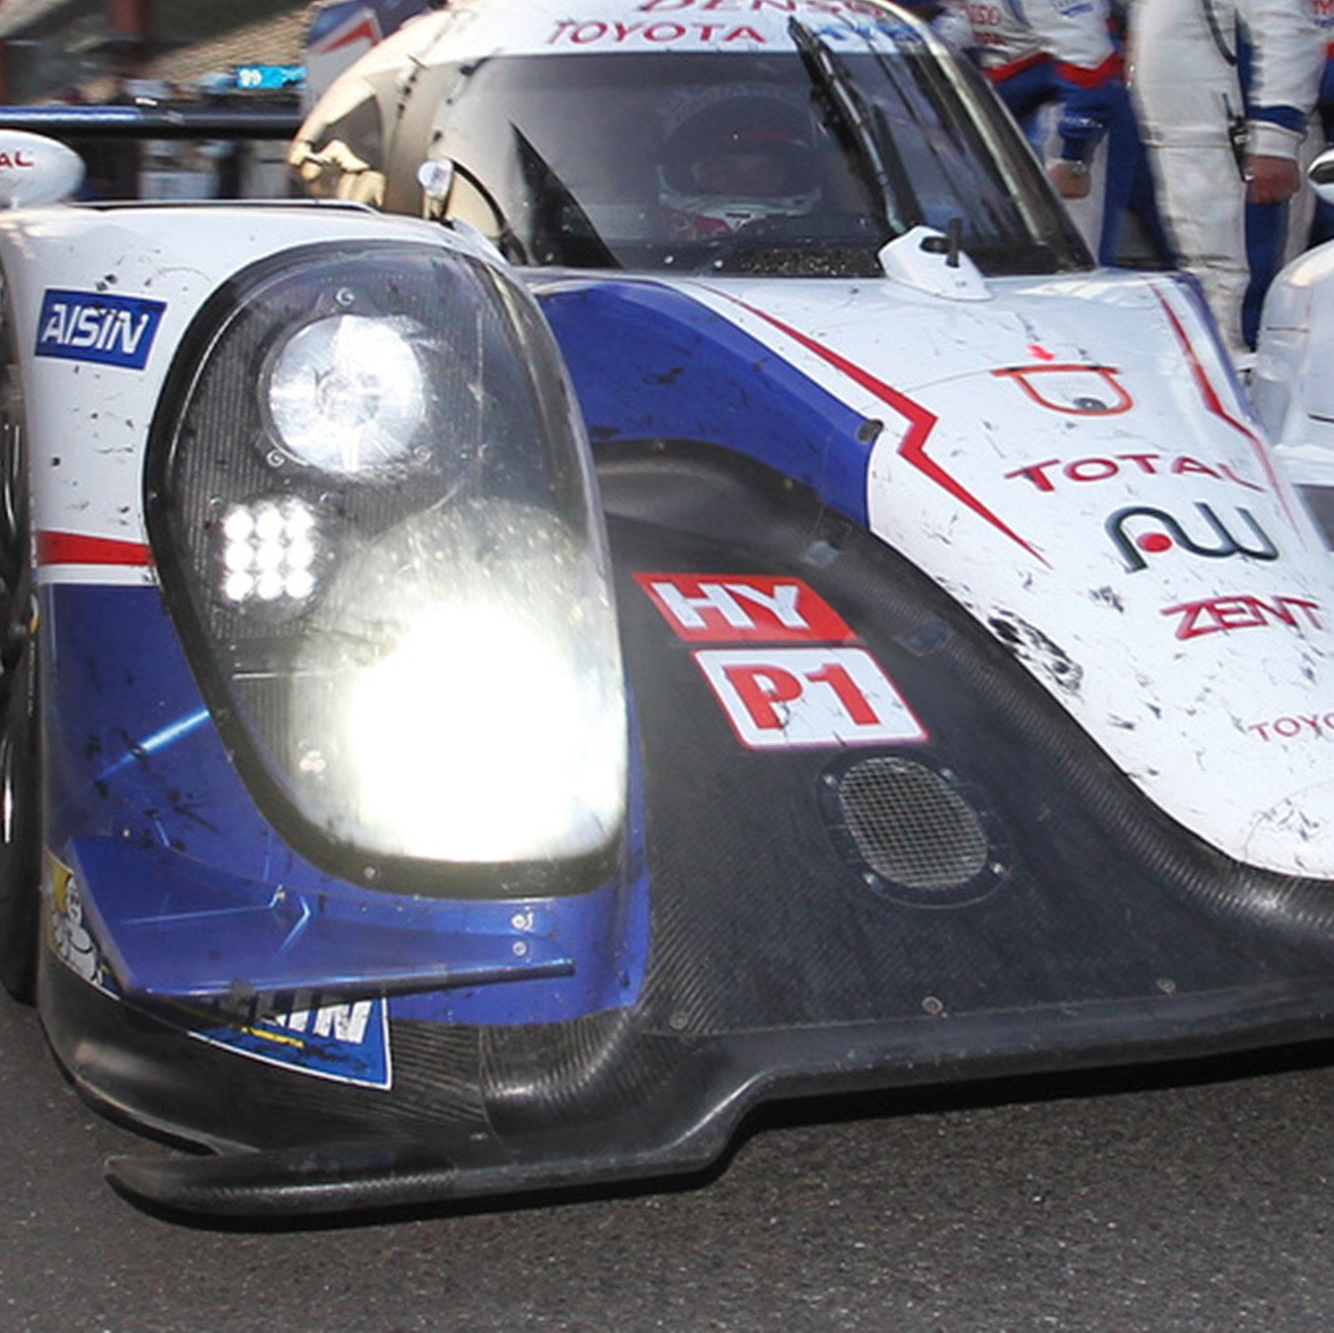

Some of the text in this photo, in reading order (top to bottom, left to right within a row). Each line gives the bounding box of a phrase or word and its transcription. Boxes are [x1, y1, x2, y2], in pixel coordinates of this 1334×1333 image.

[546, 19, 767, 46] TOYOTA
[41, 303, 150, 354] AISIN
[1004, 453, 1266, 492] TOTAL
[650, 581, 810, 630] HY
[1160, 594, 1325, 642] ZENT
[720, 662, 882, 730] P1
